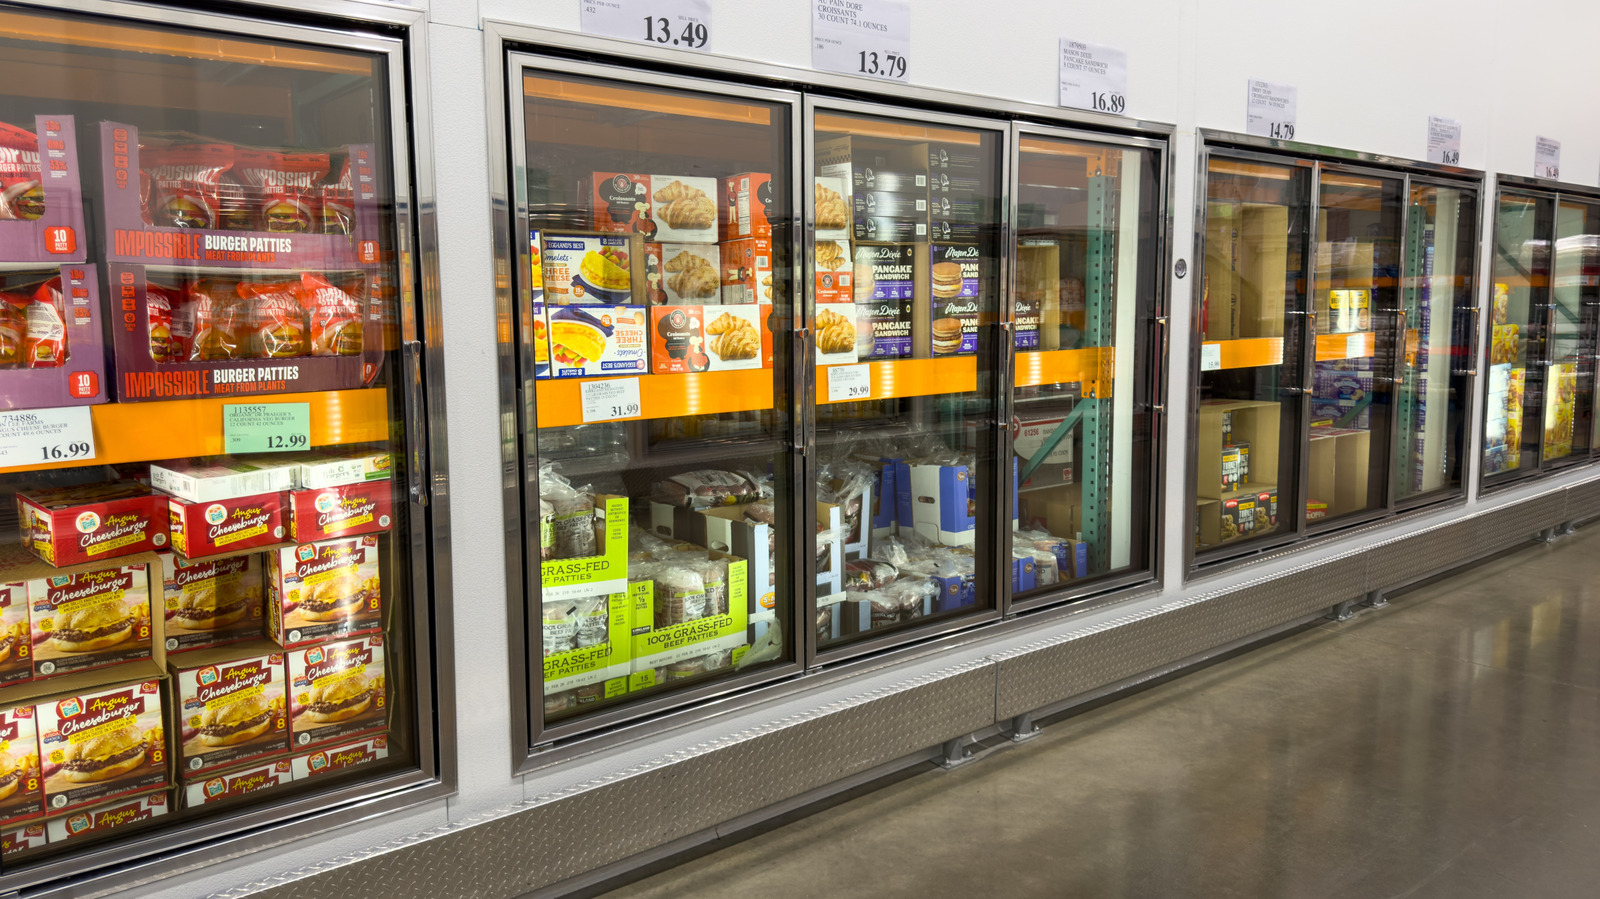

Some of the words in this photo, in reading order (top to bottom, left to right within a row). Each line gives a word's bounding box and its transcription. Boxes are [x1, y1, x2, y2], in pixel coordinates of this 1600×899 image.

[818, 5, 857, 18] CROISSANTS
[846, 1, 863, 11] DORE
[826, 14, 849, 24] COUNT
[851, 18, 861, 27] 74.1
[863, 21, 888, 32] OUNCES
[644, 16, 708, 48] 13.49
[859, 51, 906, 78] 13.79
[1064, 55, 1084, 64] PANCAKE
[1085, 60, 1108, 68] SANDWICH
[1088, 67, 1106, 75] OUNCES
[1092, 92, 1125, 113] 16.89
[1270, 122, 1294, 140] 14.79
[1442, 150, 1459, 164] 16.49
[17, 164, 41, 172] PATTIES
[159, 180, 182, 189] PATTIES
[54, 230, 67, 242] 10
[114, 229, 201, 260] IMPOSSIBLE
[205, 234, 248, 252] BURGER
[250, 237, 292, 253] PATTIES
[364, 243, 374, 253] 10
[205, 250, 225, 260] MEAT
[227, 252, 248, 262] FROM
[249, 252, 276, 262] PLANTS
[879, 248, 901, 258] Dixie
[945, 247, 968, 258] Mason
[872, 265, 912, 273] PANCAKE
[879, 305, 900, 315] Dixie
[945, 302, 968, 314] Mason
[1016, 302, 1031, 311] Dixie
[872, 322, 911, 330] PANCAKE
[78, 374, 90, 386] 10
[214, 368, 256, 384] BURGER
[258, 366, 299, 381] PATTIES
[125, 370, 210, 398] IMPOSSIBLE
[214, 382, 235, 393] MEAT
[236, 382, 257, 393] FROM
[258, 381, 286, 391] PLANTS
[849, 386, 868, 396] 29.99
[611, 404, 638, 416] 31.99
[2, 414, 37, 422] 734886
[268, 435, 306, 448] 12.99
[41, 442, 90, 460] 16.99
[341, 498, 367, 508] Angus
[232, 508, 261, 519] Angus
[319, 503, 375, 525] Cheeseburger
[105, 514, 138, 526] Angus
[209, 513, 270, 538] Cheeseburger
[81, 520, 148, 547] Cheeseburger
[322, 547, 352, 558] Angus
[298, 552, 361, 577] Cheeseburger
[541, 561, 609, 576] GRASS-FED
[79, 571, 117, 583] Angus
[178, 560, 245, 585] Cheeseburger
[554, 573, 591, 583] PATTIES
[51, 577, 128, 605] Cheeseburger
[370, 598, 378, 609] 8
[254, 607, 260, 616] 8
[140, 626, 149, 637] 8
[648, 632, 671, 645] 100%
[674, 618, 732, 638] GRASS-FED
[664, 639, 684, 648] BEEF
[687, 630, 718, 642] PATTIES
[18, 646, 28, 657] 8
[330, 648, 360, 659] Angus
[543, 647, 613, 671] GRASS-FED
[308, 652, 369, 680] Cheeseburger
[559, 661, 596, 675] PATTIES
[225, 666, 258, 680] Angus
[200, 672, 268, 702] Cheeseburger
[90, 696, 128, 711] Angus
[377, 697, 384, 707] 8
[62, 702, 140, 736] Cheeseburger
[278, 718, 285, 729] 8
[153, 750, 162, 762] 8
[334, 750, 364, 765] Angus
[27, 779, 38, 791] 8
[232, 775, 265, 790] Angus
[98, 809, 137, 826] Angus
